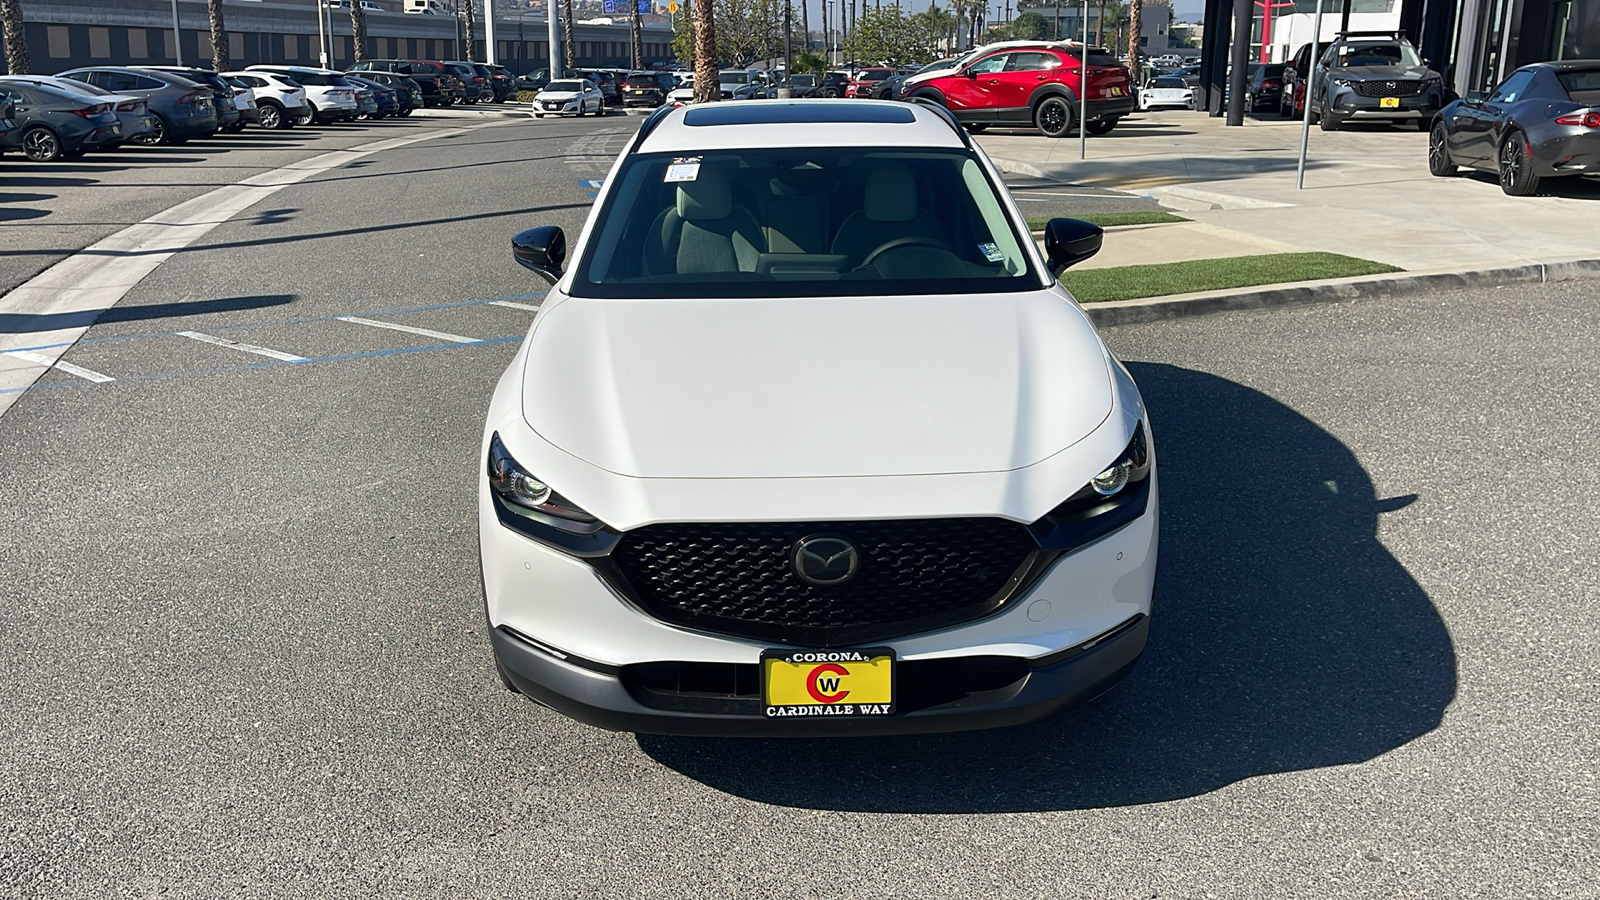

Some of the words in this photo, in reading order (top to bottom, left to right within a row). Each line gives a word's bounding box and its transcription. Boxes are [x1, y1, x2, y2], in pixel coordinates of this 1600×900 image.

[792, 651, 863, 663] CORONA
[766, 705, 854, 717] CARDINALE
[860, 704, 891, 715] WAY
